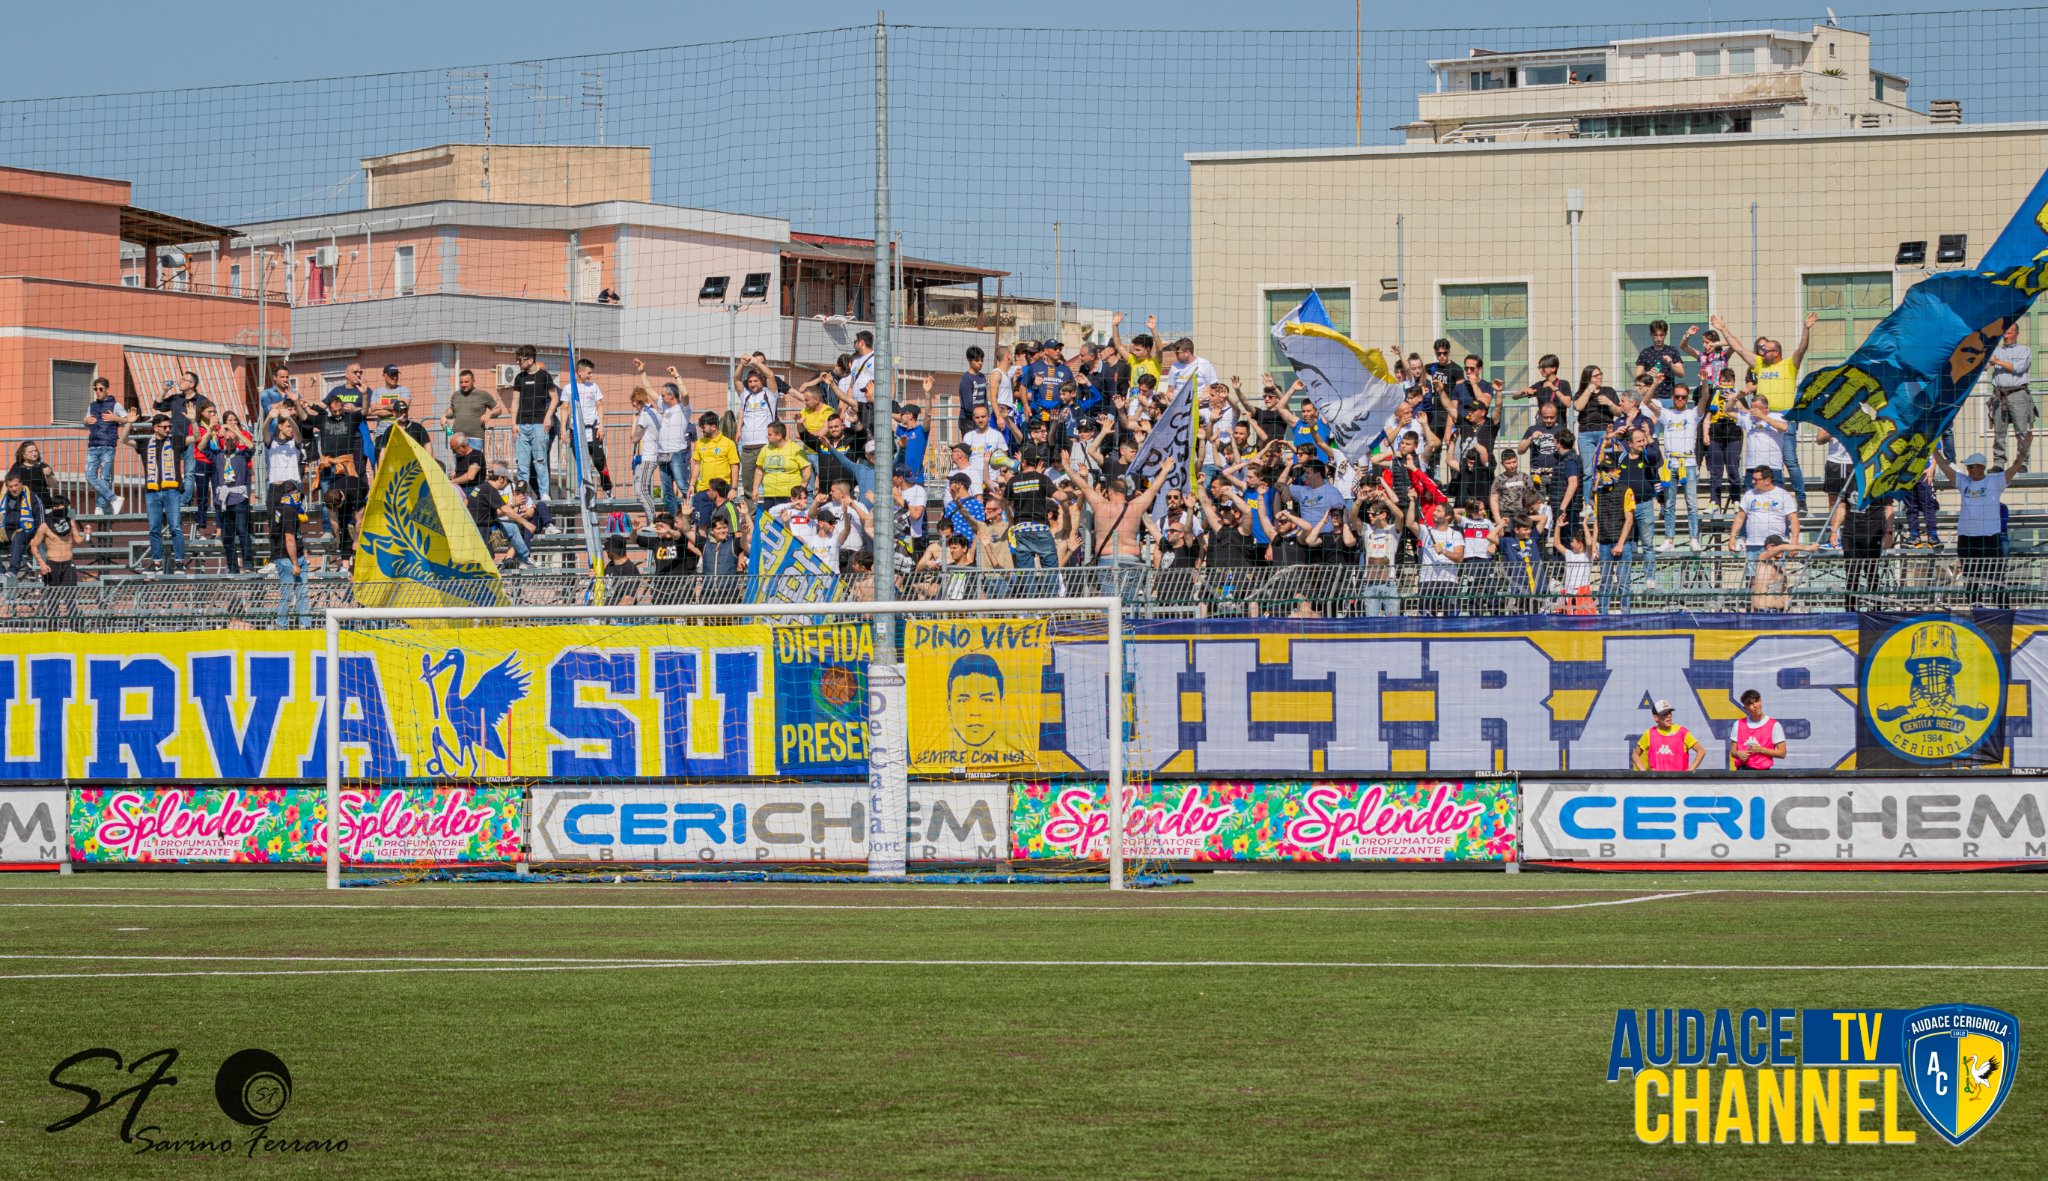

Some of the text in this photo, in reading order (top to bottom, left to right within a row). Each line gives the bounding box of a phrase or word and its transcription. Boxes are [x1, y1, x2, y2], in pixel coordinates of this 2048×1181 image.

[915, 622, 1042, 649] DINO VIVE!
[779, 623, 875, 664] DIFFIDA
[1050, 636, 1858, 772] ULTRAS
[1892, 734, 1973, 757] CERIGNOLA
[1922, 734, 1943, 743] 1984
[917, 750, 966, 764] SEMPRE
[971, 750, 999, 764] CON
[98, 791, 265, 857] Splendeo
[320, 789, 492, 856] Splendeo
[1291, 785, 1482, 857] Splendeo
[1559, 794, 2046, 841] CERICHEM
[143, 840, 152, 848] IL
[160, 839, 241, 848] PROFUMATORE
[365, 839, 375, 848] IL
[383, 839, 465, 848] PROFUMATORE
[1122, 838, 1201, 847] ROFUMATORE
[1342, 838, 1351, 846] IL
[1362, 837, 1452, 846] PROFUMATORE
[154, 848, 231, 857] IGIENIZZANTE
[377, 848, 456, 857] IGIENIZZANTE
[600, 845, 997, 862] BIOPHRM
[1106, 847, 1190, 857] IENIZZANTE
[1355, 846, 1441, 856] IGIENIZZANTE
[1599, 842, 2047, 859] BIOPHARM
